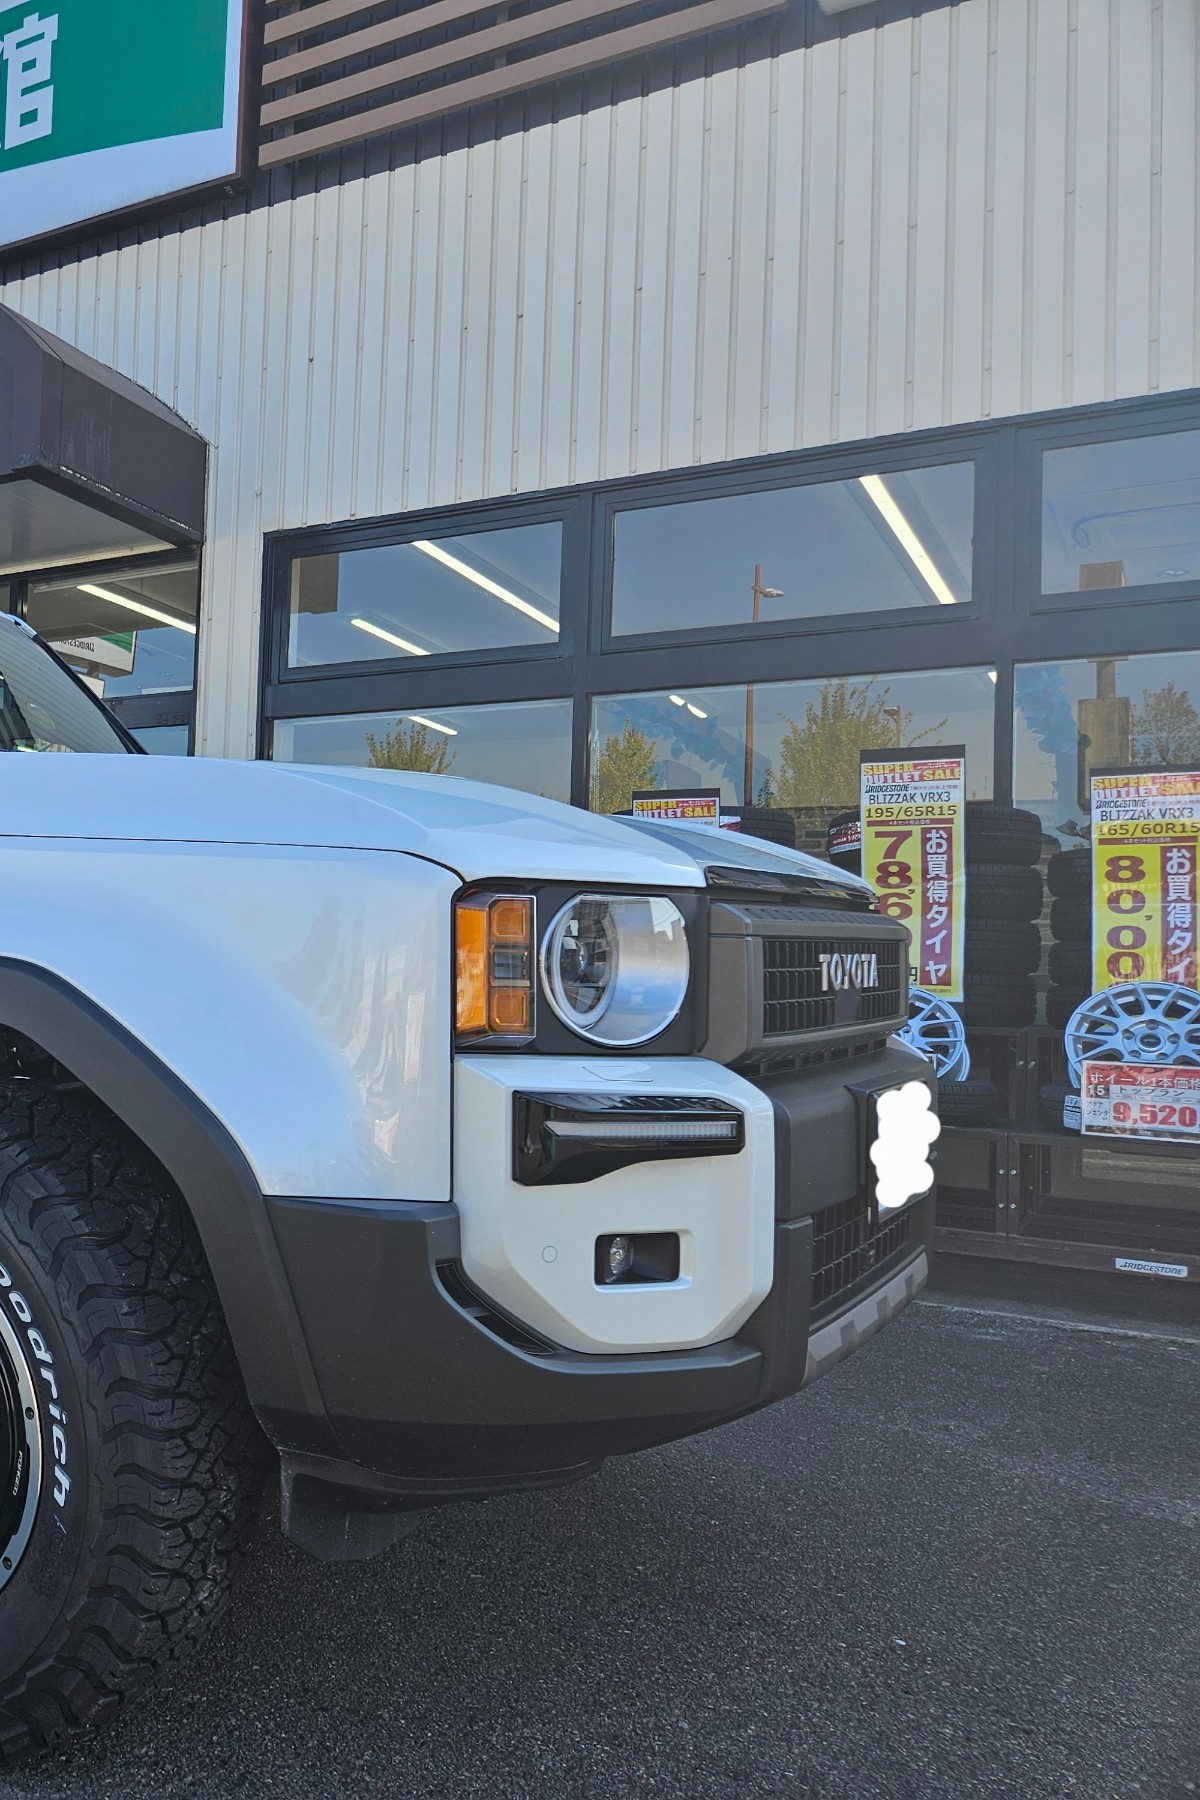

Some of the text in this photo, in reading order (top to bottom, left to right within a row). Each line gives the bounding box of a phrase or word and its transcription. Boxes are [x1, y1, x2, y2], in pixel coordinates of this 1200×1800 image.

[864, 763, 914, 776] SUPER
[923, 768, 960, 780] SALE
[865, 784, 910, 794] BRIDGESTONE
[1094, 776, 1152, 791] SUPER
[868, 791, 951, 805] BLIZZAK VRX3
[1095, 799, 1147, 809] BRIDGESTONE
[635, 801, 677, 811] SUPER
[684, 805, 716, 817] SALE
[865, 805, 957, 819] 195/65R15
[1100, 807, 1194, 822] BLIZZAK VRX3
[1098, 822, 1200, 836] 165/60R15
[925, 829, 948, 985] お買得タイヤ
[819, 952, 878, 991] TOYOTA
[1087, 1085, 1105, 1096] 15
[1112, 1101, 1198, 1128] 9,520
[1120, 1262, 1184, 1275] BRIDGESTONE
